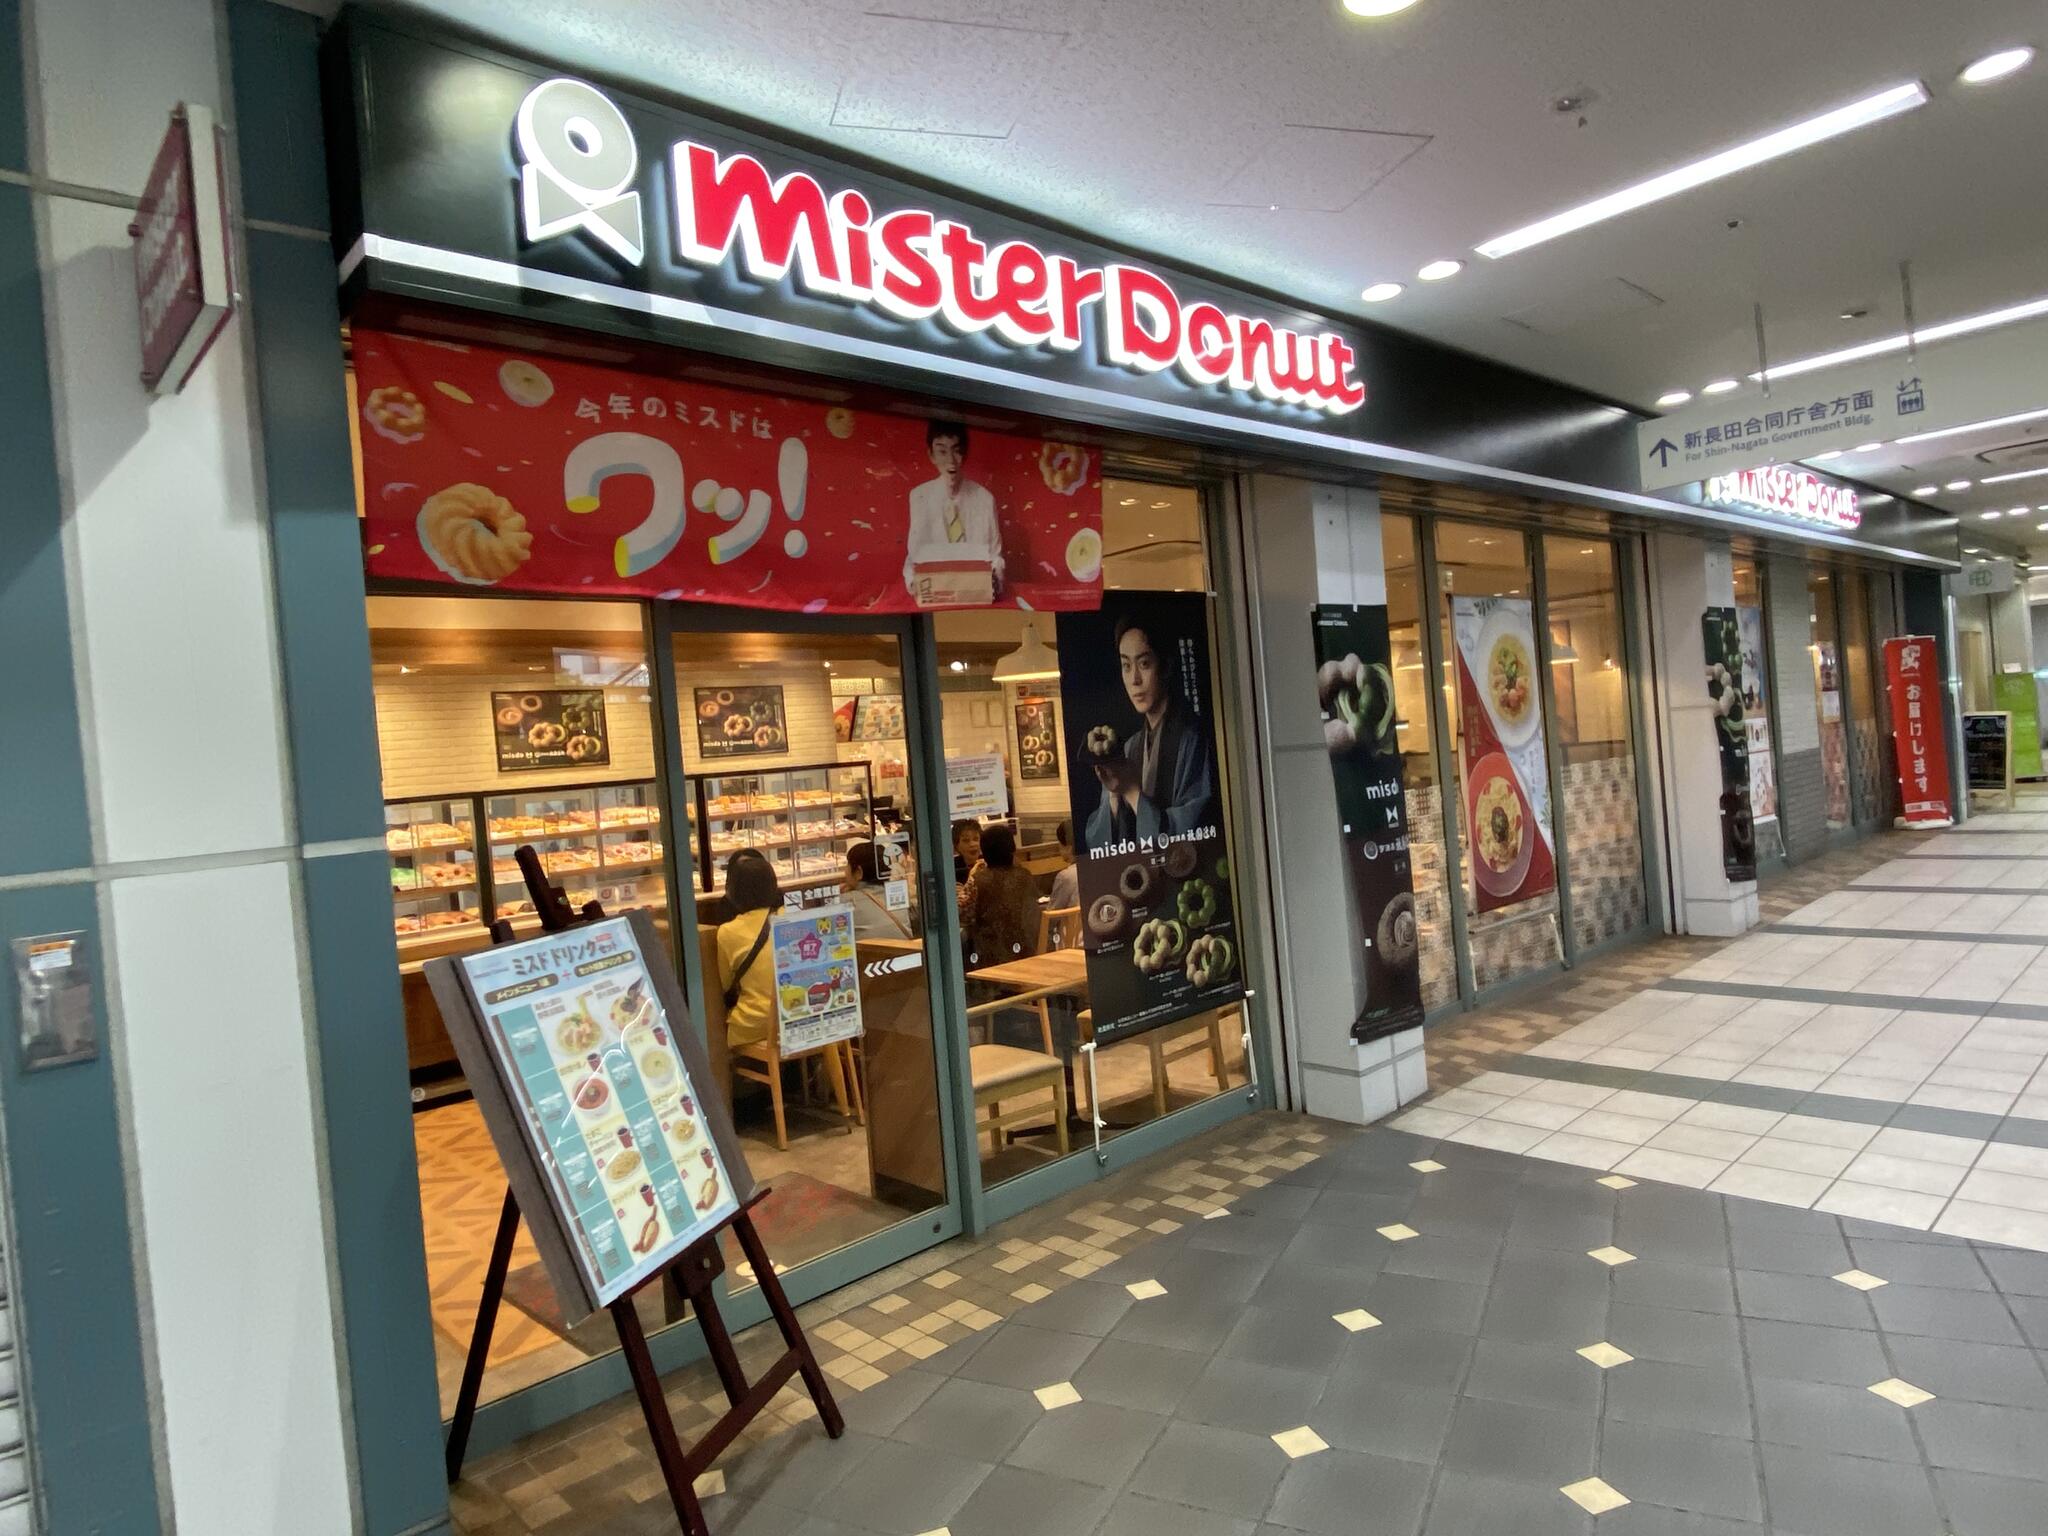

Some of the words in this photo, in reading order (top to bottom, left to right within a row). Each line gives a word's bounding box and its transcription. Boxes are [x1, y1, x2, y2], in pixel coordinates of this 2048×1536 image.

[1104, 263, 1366, 416] Donut
[575, 392, 773, 440] 今年のミスドは
[1684, 389, 1874, 450] 新長田合同庁舎方面
[1685, 450, 1701, 463] For
[1704, 436, 1769, 458] Shin-Nagata
[1771, 419, 1842, 443] Government
[1844, 413, 1875, 428] Bldg.
[1906, 684, 1928, 793] お届けします
[1365, 777, 1400, 801] misd
[1090, 838, 1137, 860] misdo
